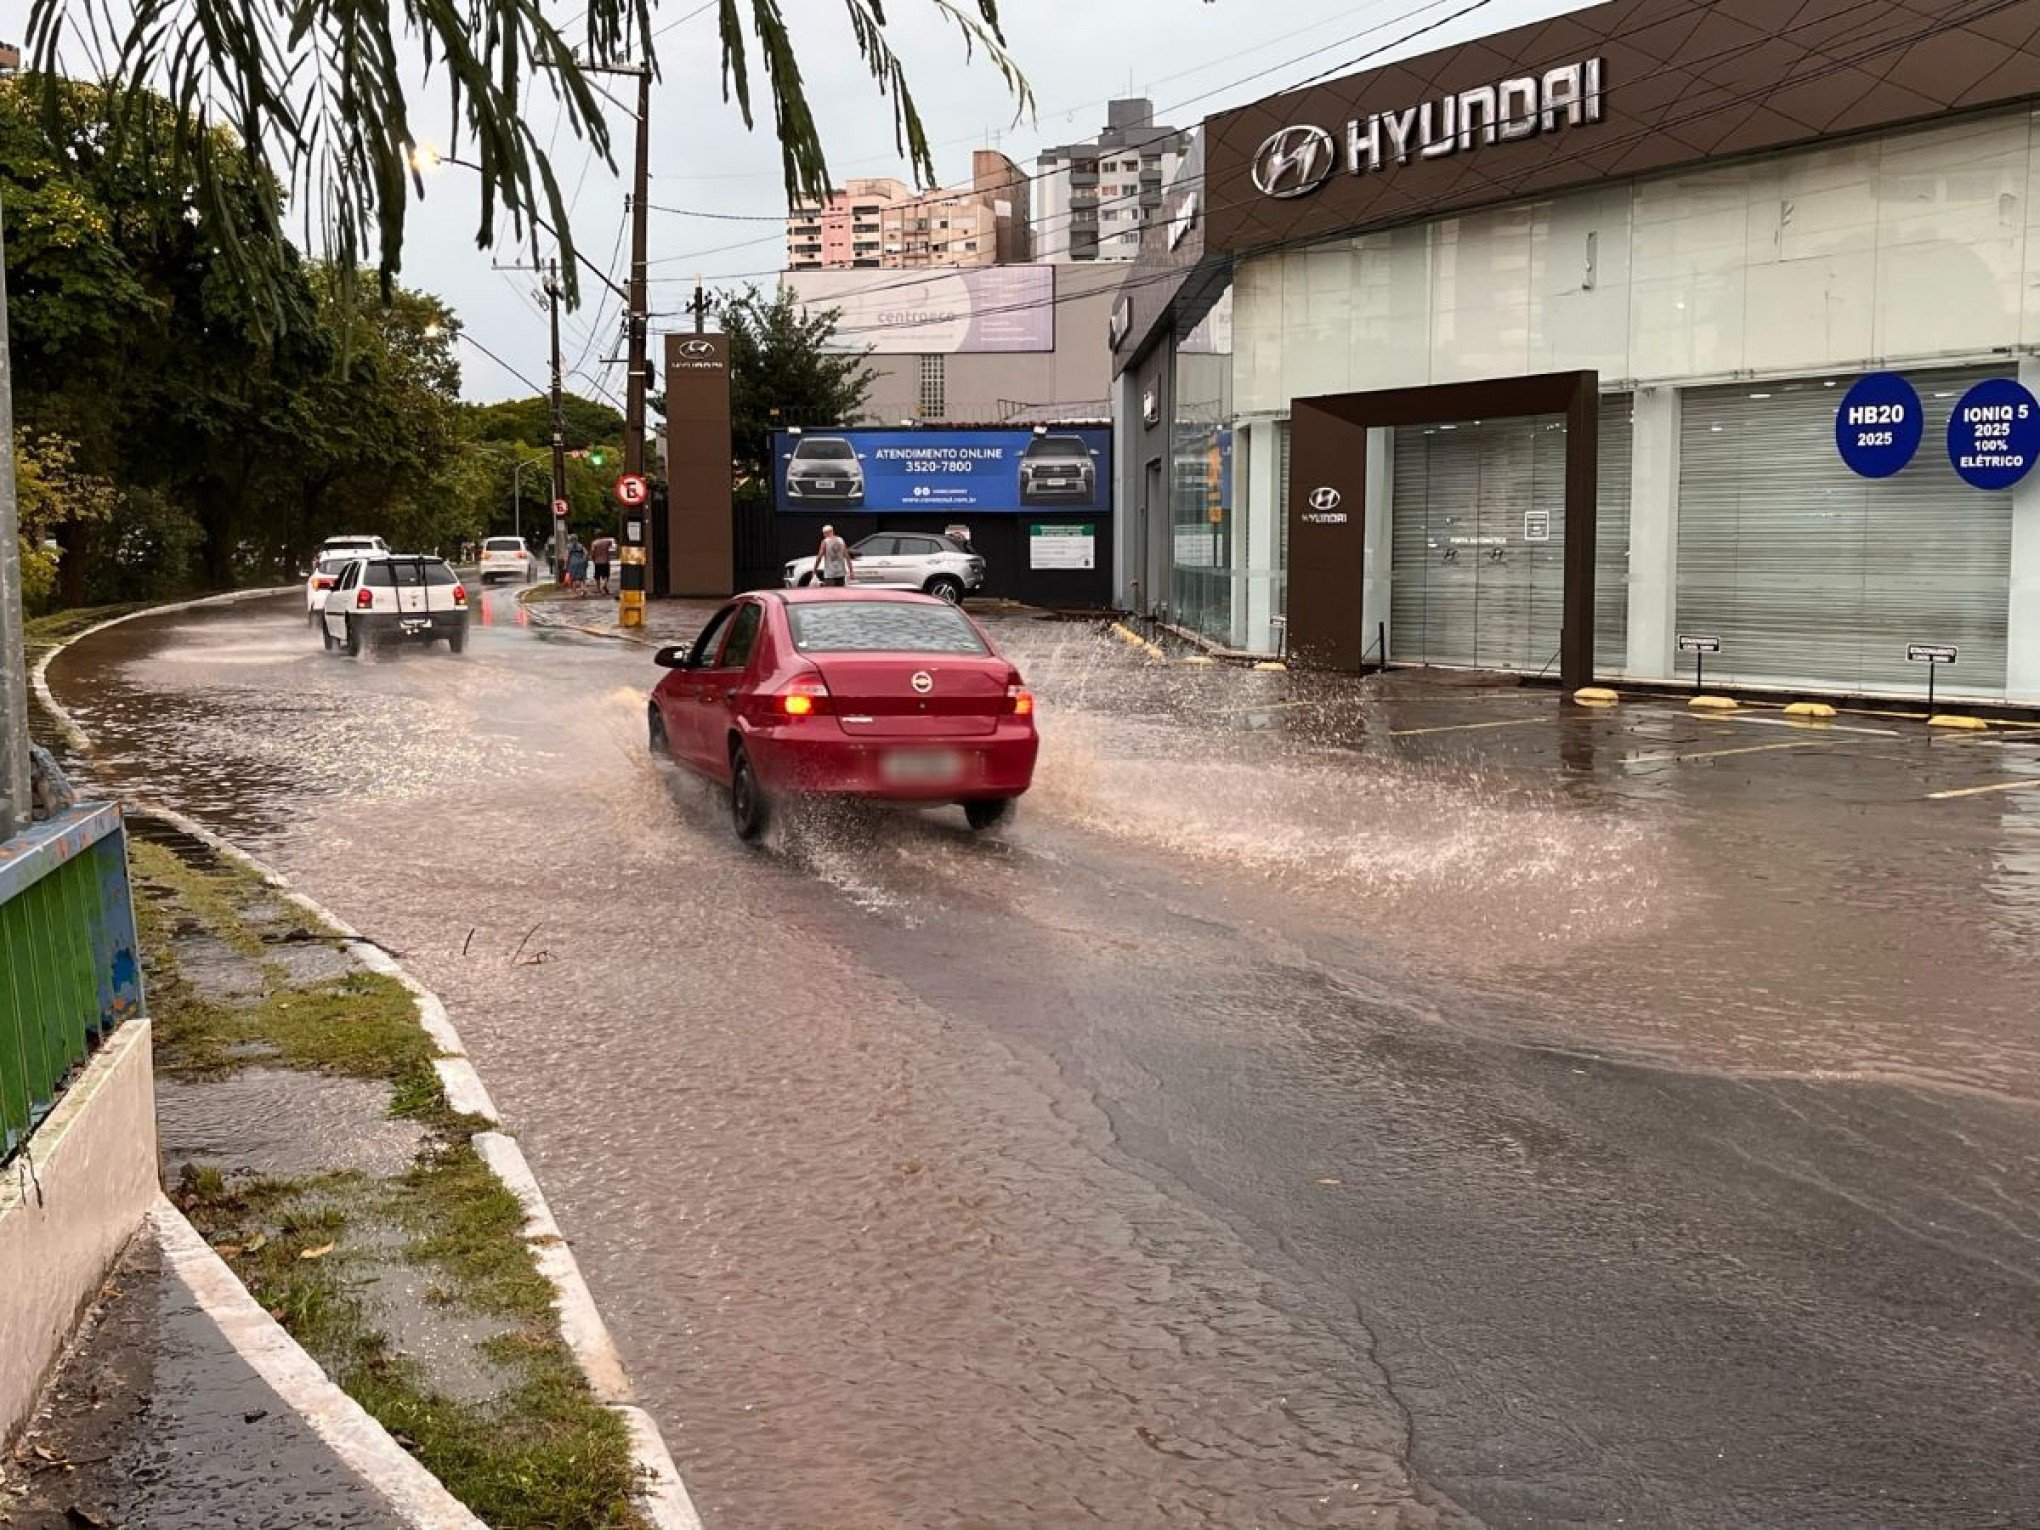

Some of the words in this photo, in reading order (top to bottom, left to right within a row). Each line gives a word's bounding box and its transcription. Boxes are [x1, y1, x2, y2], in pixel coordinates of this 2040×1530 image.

[1348, 57, 1602, 175] HYUNDAI
[1849, 404, 1904, 425] HB20
[1963, 405, 2013, 422] IONIQ
[2017, 404, 2029, 419] 5
[1974, 423, 2010, 437] 2025
[1857, 431, 1893, 446] 2025
[1974, 439, 2009, 452] 100%
[875, 448, 957, 460] ATENDIMENTO
[958, 448, 1004, 459] ONLINE
[1960, 453, 2024, 468] ELÉTRICO
[905, 460, 972, 472] 3520-7800
